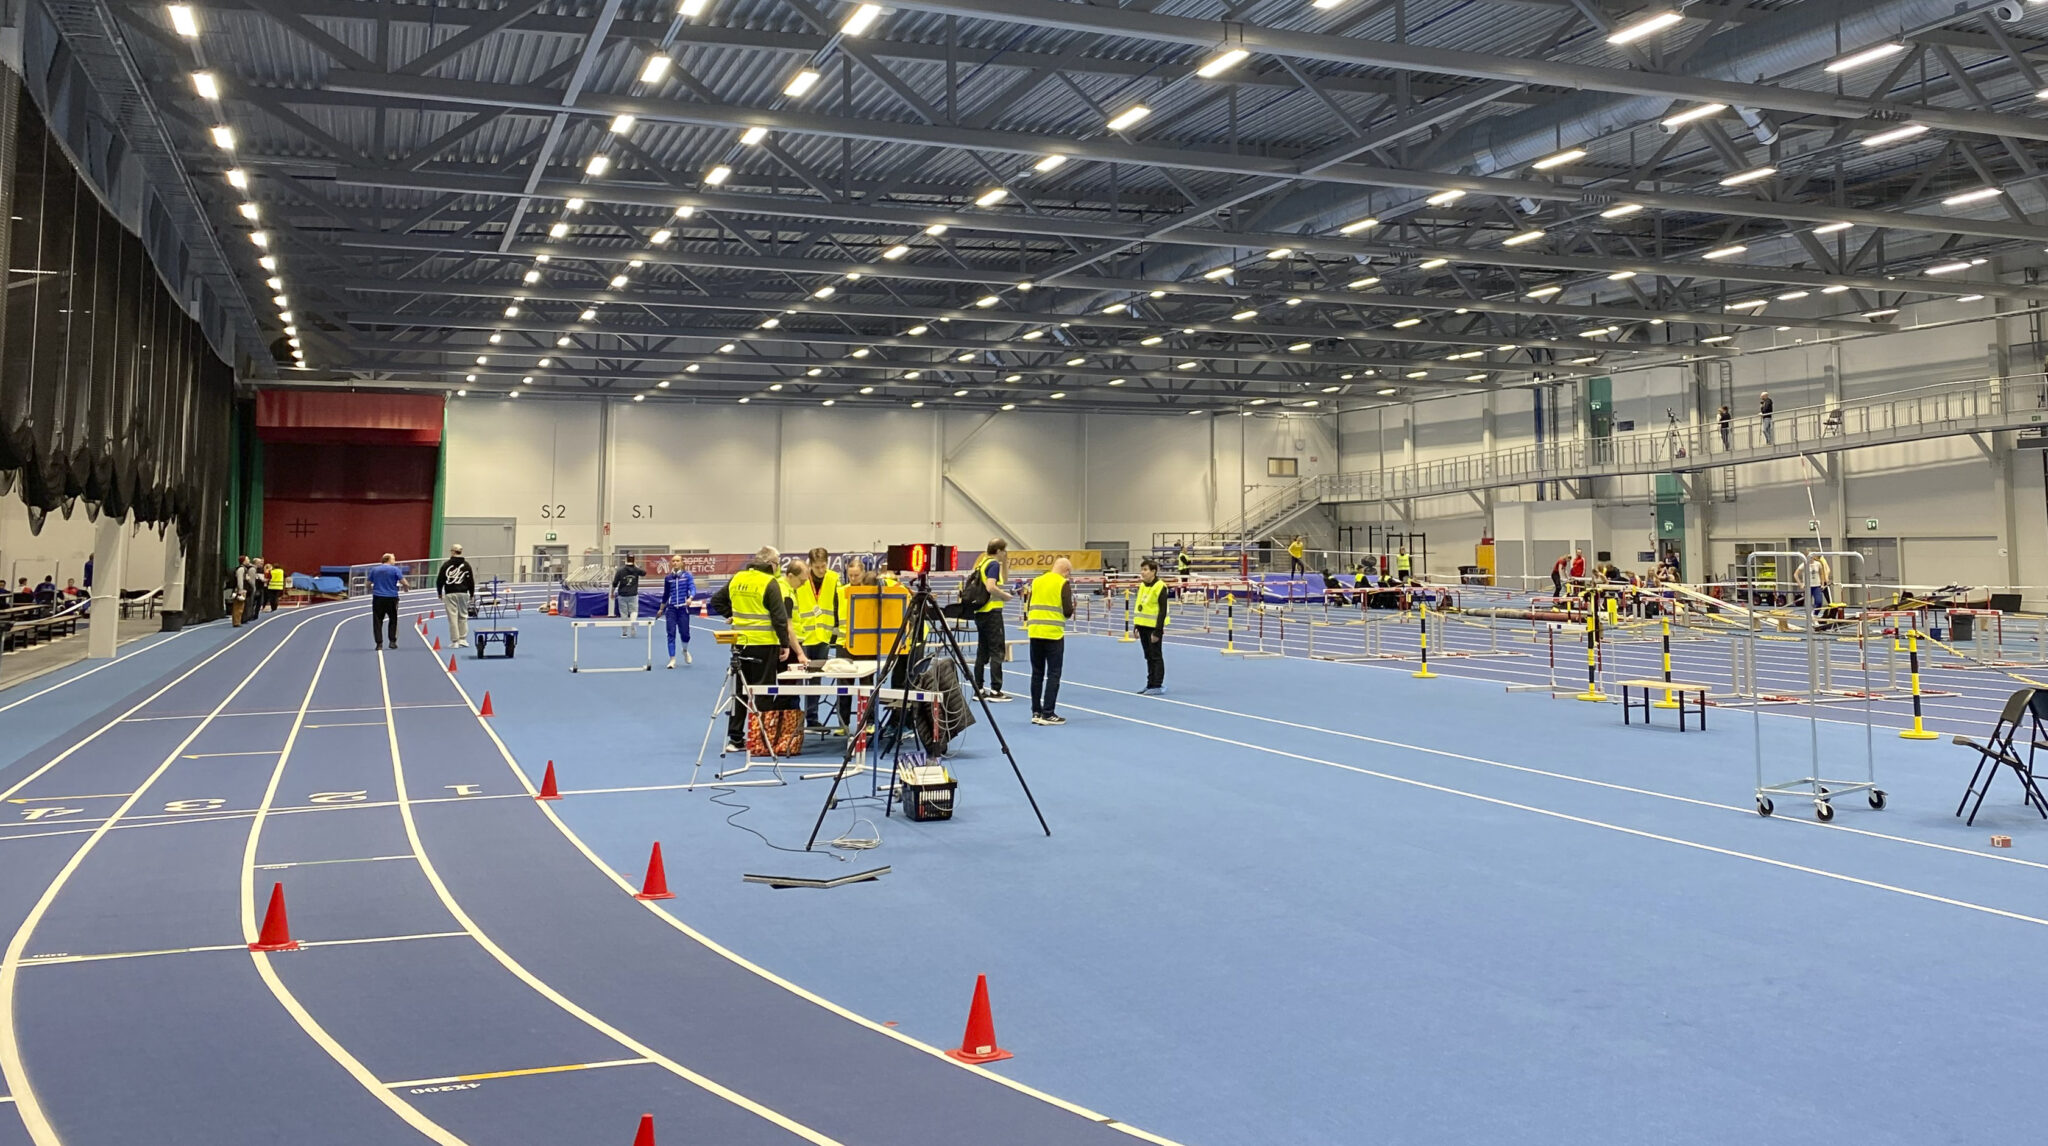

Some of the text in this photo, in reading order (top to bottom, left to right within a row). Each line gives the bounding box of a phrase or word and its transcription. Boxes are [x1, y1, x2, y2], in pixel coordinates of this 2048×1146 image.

[541, 504, 566, 519] S.2
[632, 504, 653, 519] S.1
[683, 557, 716, 565] ROPEAN
[911, 544, 924, 572] 0
[308, 790, 367, 803] 2
[444, 784, 483, 796] 1
[164, 798, 226, 812] 3
[20, 807, 84, 820] 4
